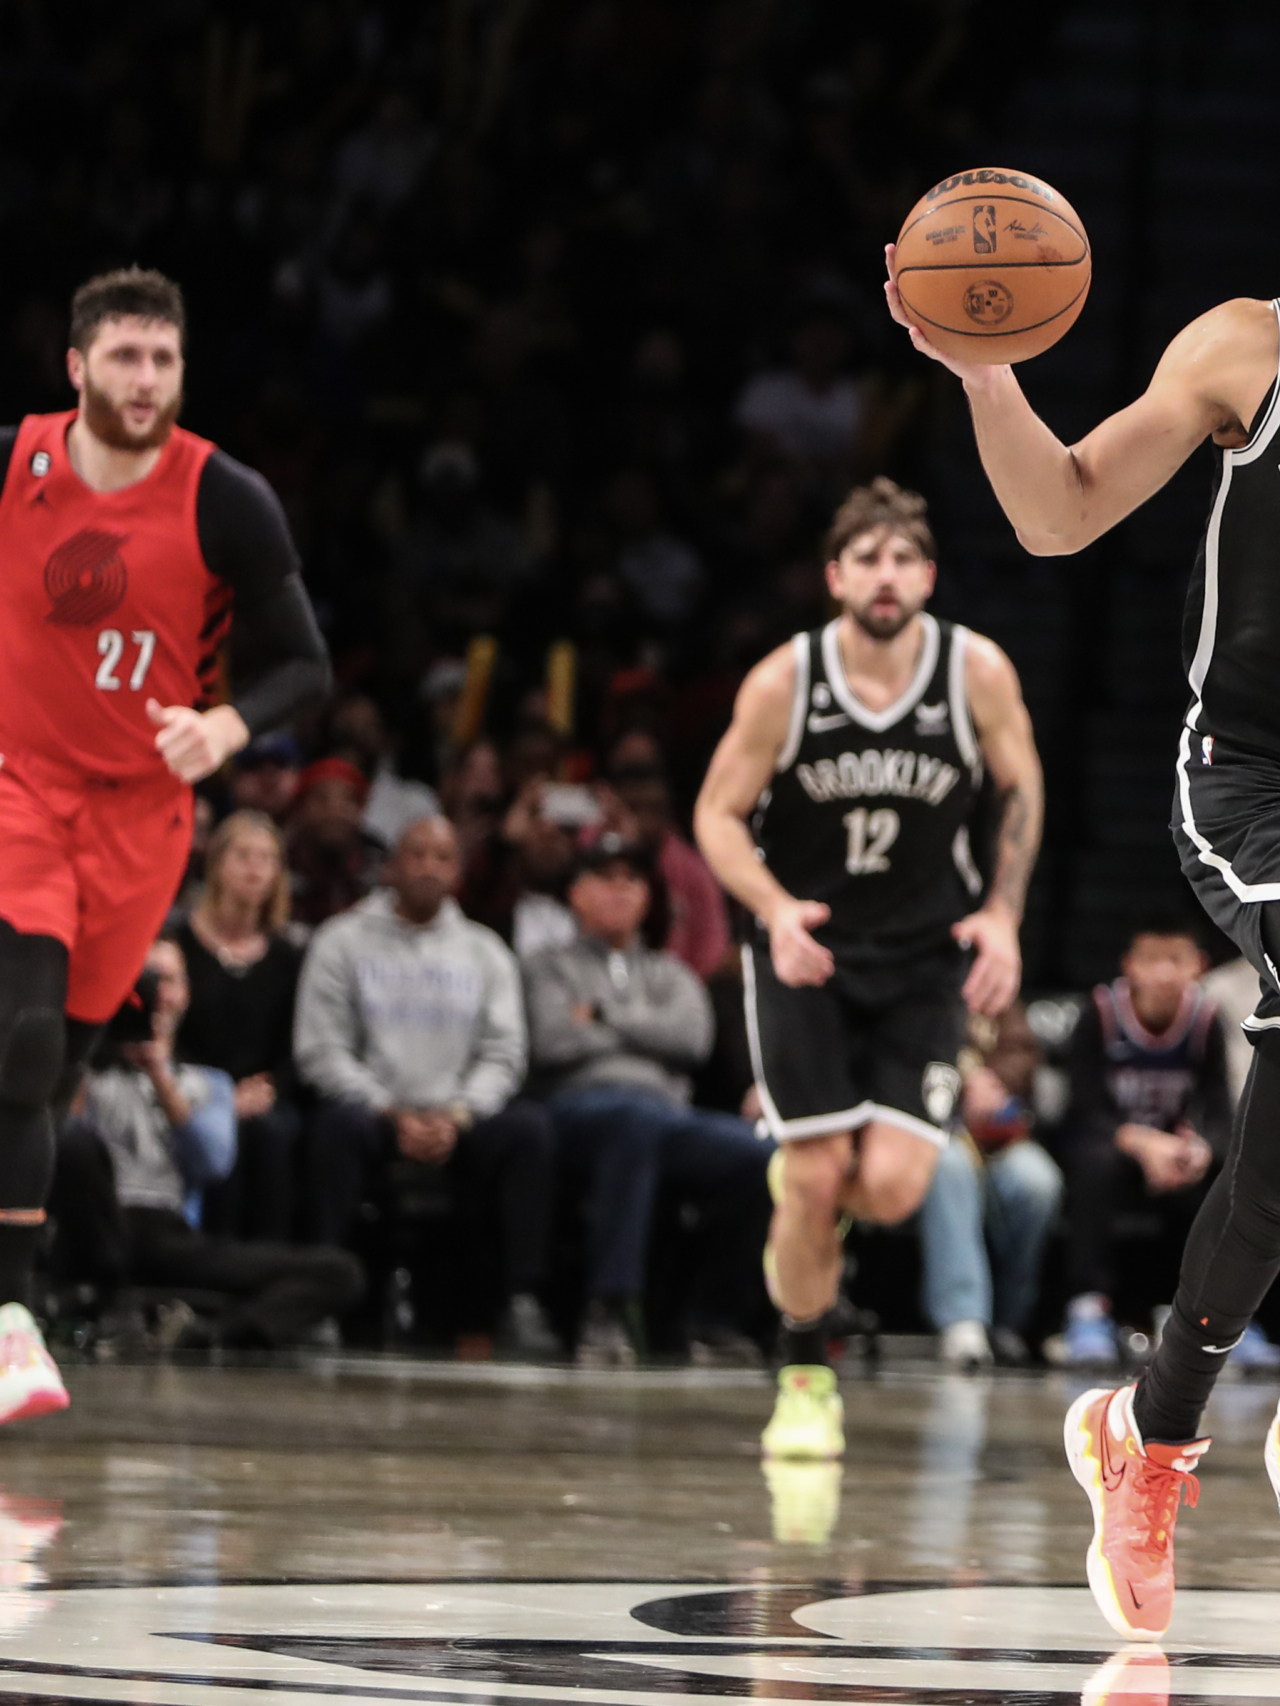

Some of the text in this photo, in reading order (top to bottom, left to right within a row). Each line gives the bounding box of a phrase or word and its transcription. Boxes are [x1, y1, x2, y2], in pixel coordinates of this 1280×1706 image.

[31, 451, 50, 477] 6
[95, 629, 156, 691] 27
[796, 748, 960, 806] BROOKLYN
[842, 807, 900, 875] 12
